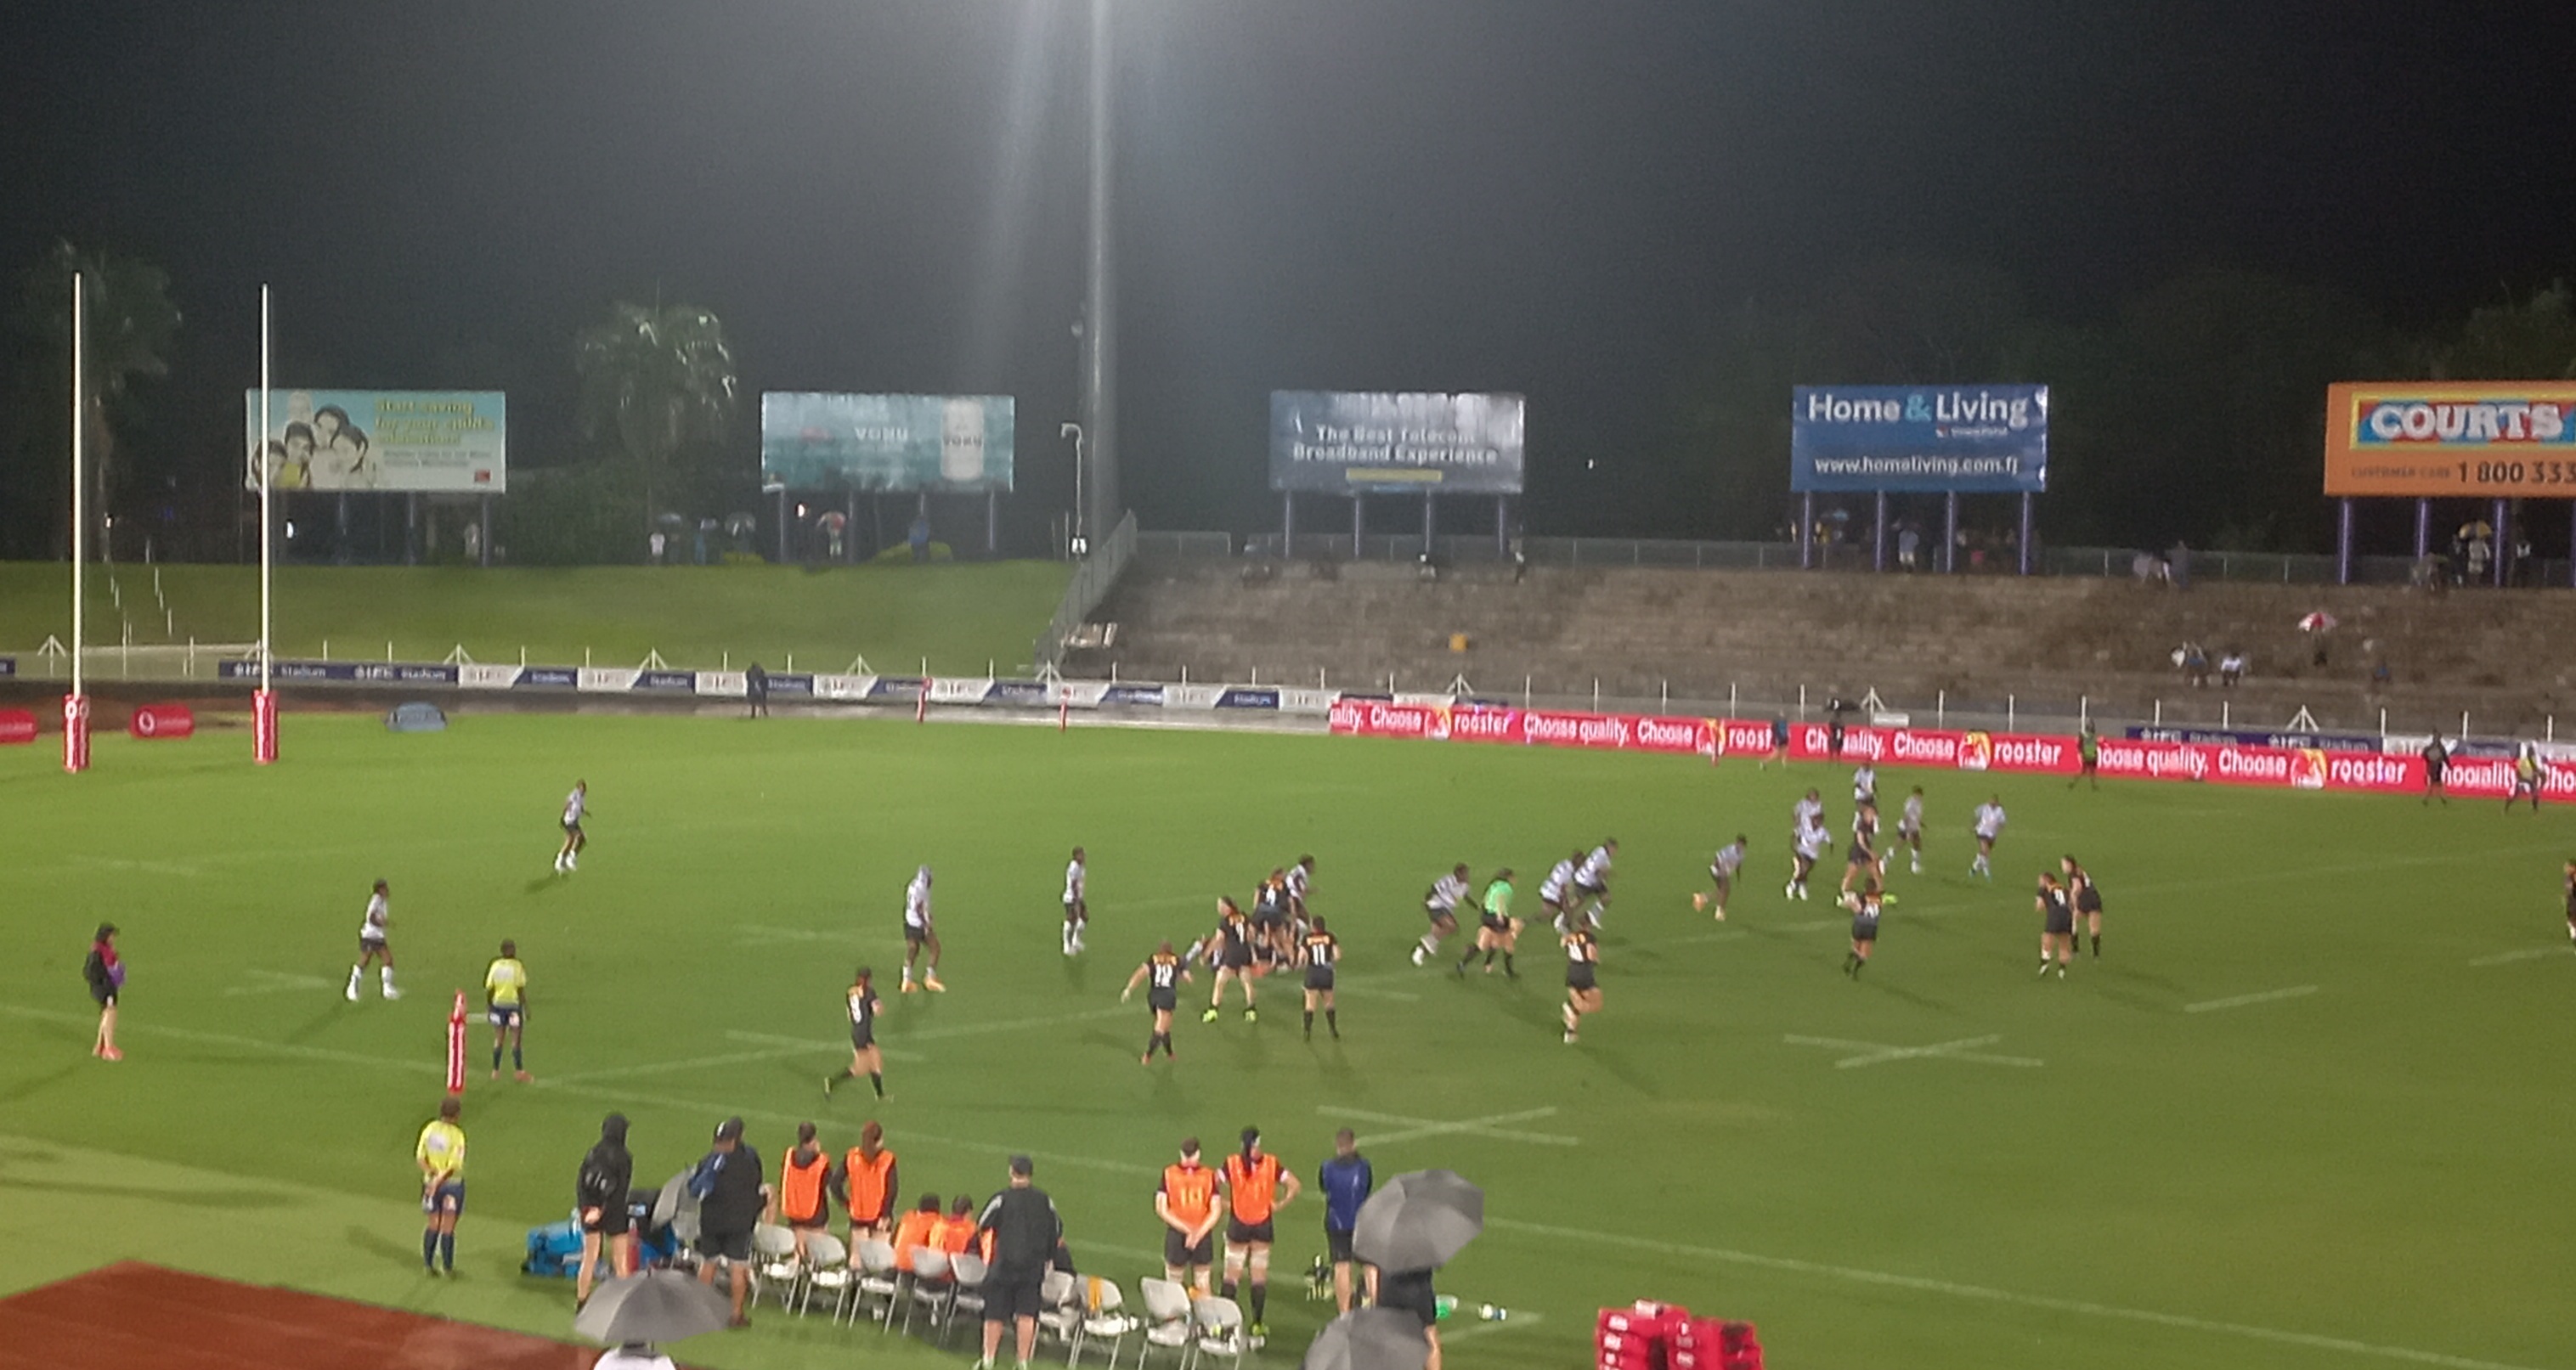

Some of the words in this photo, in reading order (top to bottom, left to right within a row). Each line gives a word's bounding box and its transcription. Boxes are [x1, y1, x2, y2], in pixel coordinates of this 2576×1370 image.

[1808, 393, 1901, 422] Home
[1905, 394, 1932, 422] &
[1936, 392, 2029, 431] Living
[2371, 403, 2563, 440] COURTS
[1317, 426, 1349, 442] The
[1353, 426, 1393, 443] Best
[1293, 441, 1391, 461] Broadband
[1394, 444, 1498, 465] Experience
[1815, 455, 2019, 477] www.homeliving.com.fj
[2459, 462, 2468, 483] 1
[2477, 461, 2524, 483] 800
[1370, 704, 1422, 731] Choose
[1455, 711, 1510, 734] rooster
[1524, 713, 1577, 741] Choose
[1579, 717, 1630, 747] quality.
[1637, 718, 1693, 745] Choose
[1729, 724, 1773, 750] roost
[1894, 731, 1955, 759] Choose
[1994, 741, 2062, 764] rooster
[2147, 746, 2209, 779] quality.
[2219, 748, 2287, 779] Choose
[2330, 756, 2407, 784] rooster
